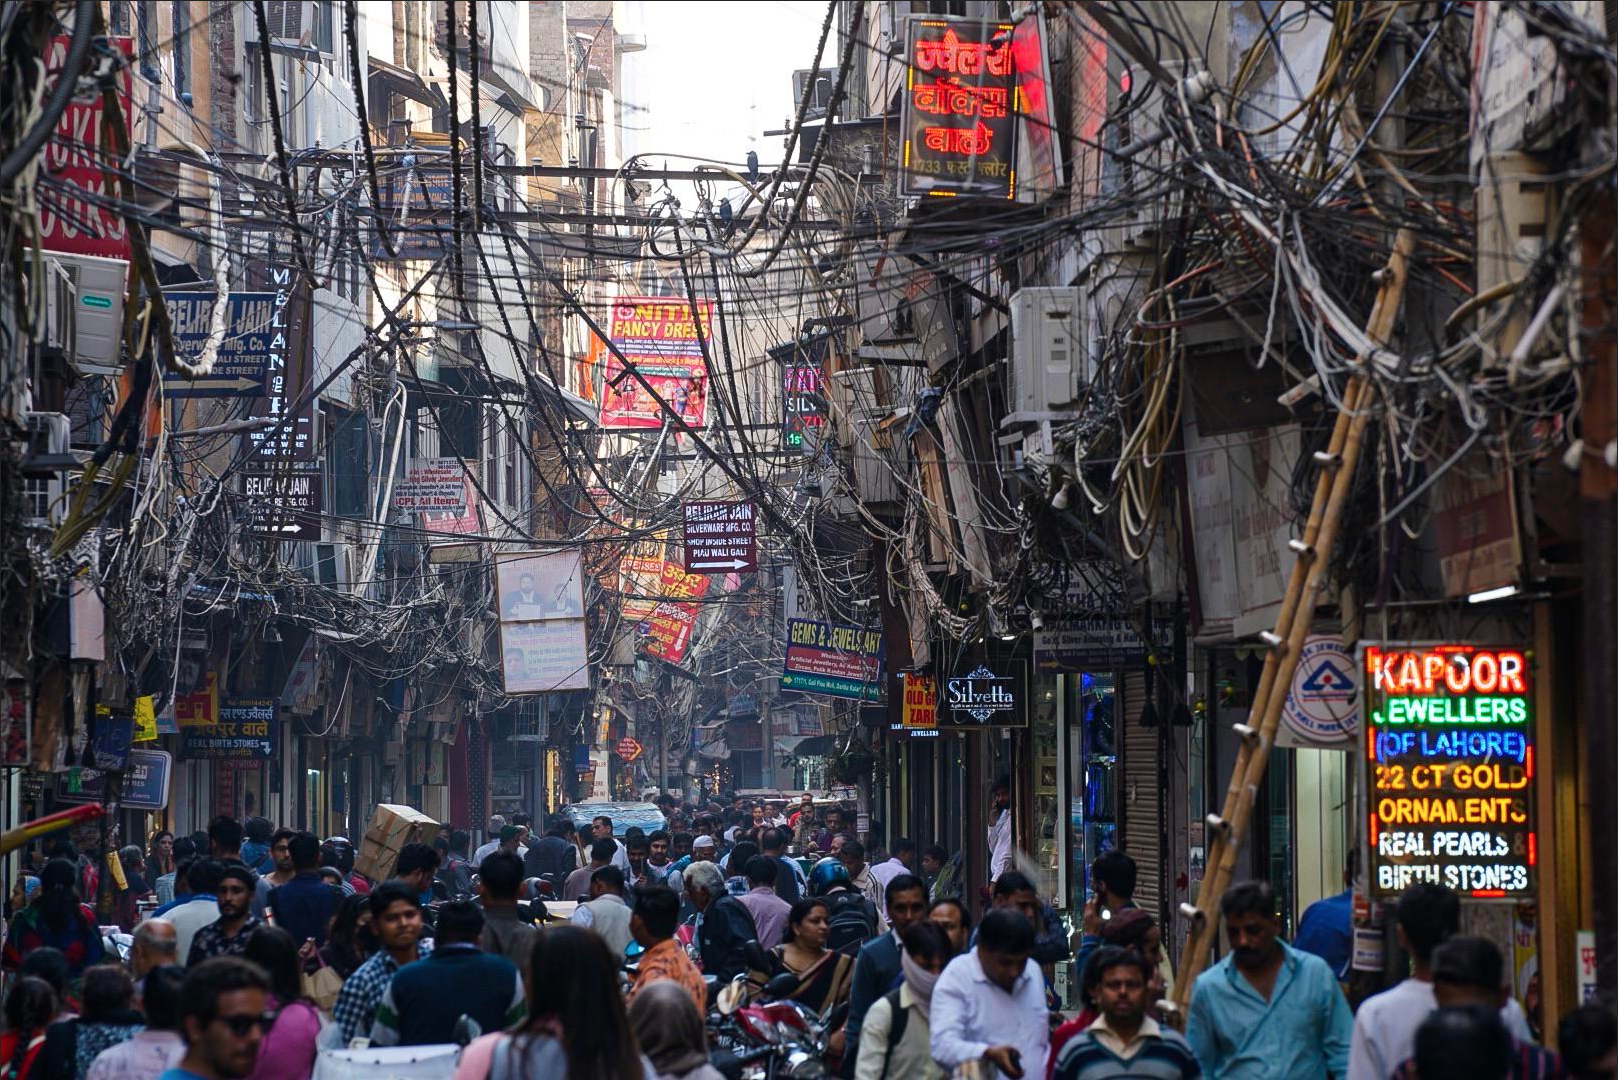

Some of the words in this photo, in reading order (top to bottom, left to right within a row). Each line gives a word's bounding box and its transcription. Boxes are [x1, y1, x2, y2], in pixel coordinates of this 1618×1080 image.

[237, 300, 272, 333] JAIN
[614, 321, 660, 337] FANCY
[664, 322, 709, 338] DRESS
[250, 337, 265, 351] Co.
[234, 355, 267, 363] STREET
[289, 478, 309, 495] JAIN
[730, 504, 751, 520] JAIN
[687, 523, 724, 534] SILVERWARE
[726, 522, 740, 532] MFG.
[742, 522, 752, 532] CO.
[728, 537, 752, 545] STREET
[711, 548, 728, 557] WALI
[731, 548, 747, 556] GALI
[791, 622, 816, 644] GEMS
[819, 627, 825, 647] &
[827, 628, 861, 651] JEWELS
[1373, 652, 1525, 691] KAPOOR
[948, 680, 1013, 703] Silvetta
[1373, 697, 1526, 723] JEWELLERS
[242, 720, 268, 736] वाले
[210, 740, 232, 748] BIRTH
[235, 740, 259, 748] STONES
[1376, 731, 1416, 762] (OF
[1421, 731, 1526, 762] LAHORE)
[1375, 764, 1406, 789] 22
[1411, 764, 1447, 789] CT
[1453, 764, 1527, 789] GOLD
[1379, 832, 1431, 856] REAL
[1433, 832, 1509, 856] PEARLS
[1379, 865, 1440, 889] BIRTH
[1445, 865, 1527, 890] STONES
